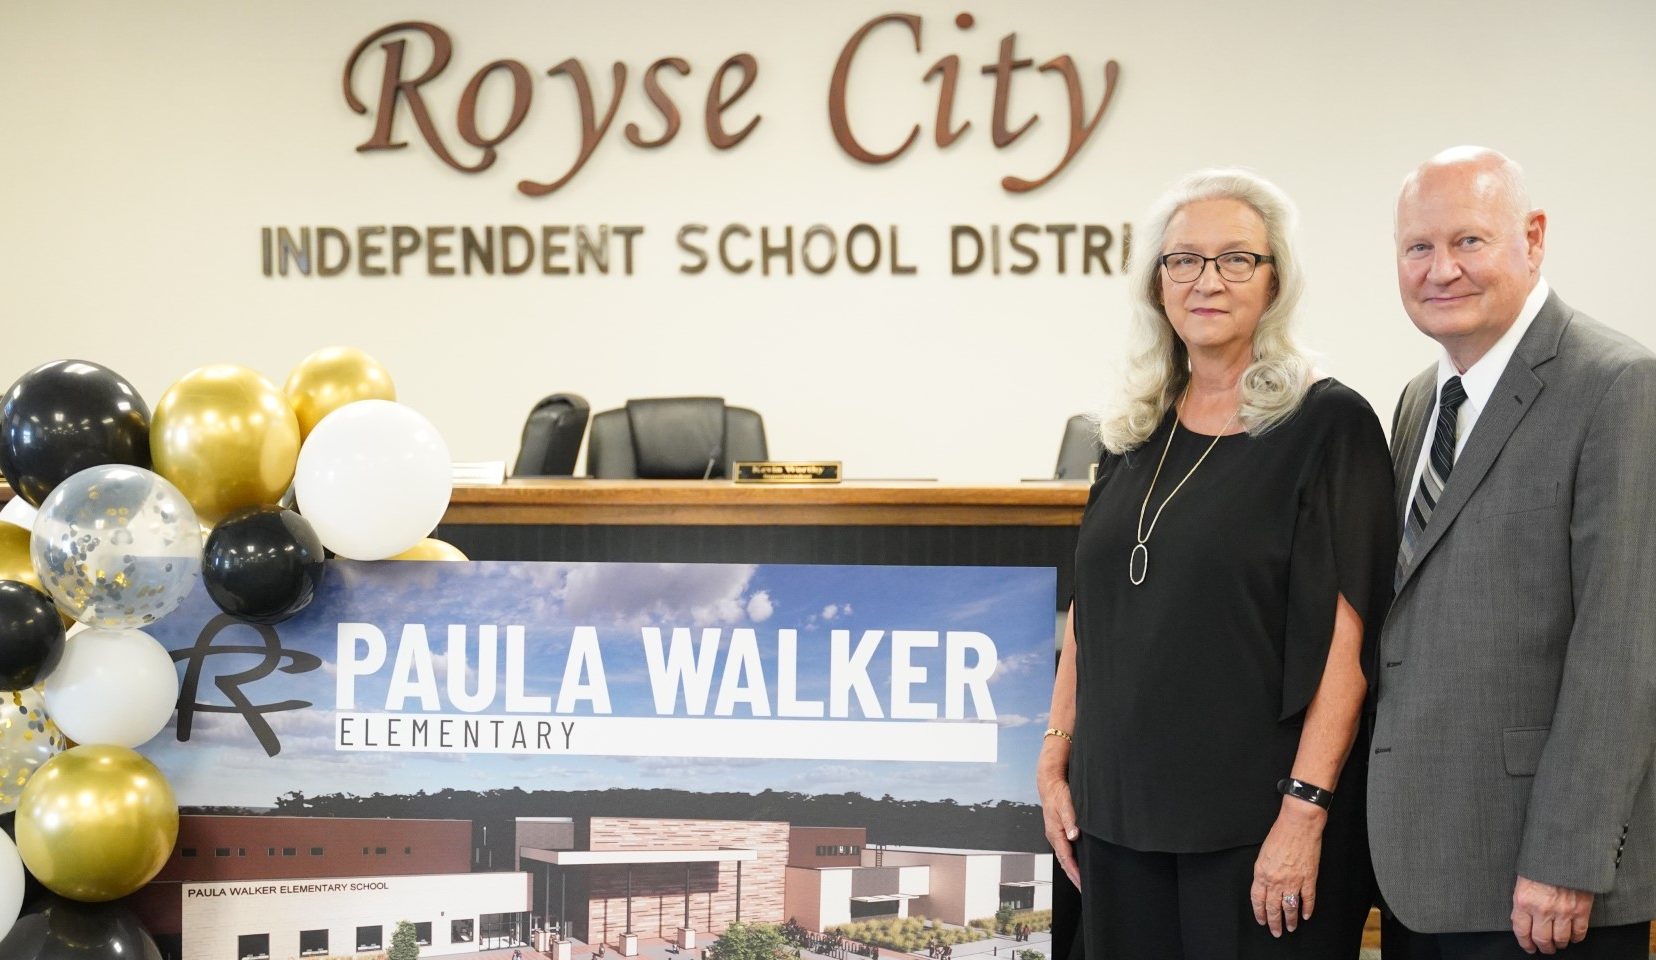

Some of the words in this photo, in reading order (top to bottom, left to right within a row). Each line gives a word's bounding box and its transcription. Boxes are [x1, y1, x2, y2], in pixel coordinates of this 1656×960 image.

[343, 20, 761, 197] Royse
[828, 12, 1119, 194] City
[260, 224, 645, 278] INDEPENDENT
[676, 223, 918, 277] SCHOOL
[335, 622, 612, 714] PAULA
[640, 626, 998, 721] WALKER
[339, 717, 576, 750] ELEMENTARY
[187, 887, 227, 898] PAULA
[229, 885, 277, 896] WALKER
[279, 883, 348, 894] ELEMENTARY
[350, 881, 389, 891] SCHOOL
